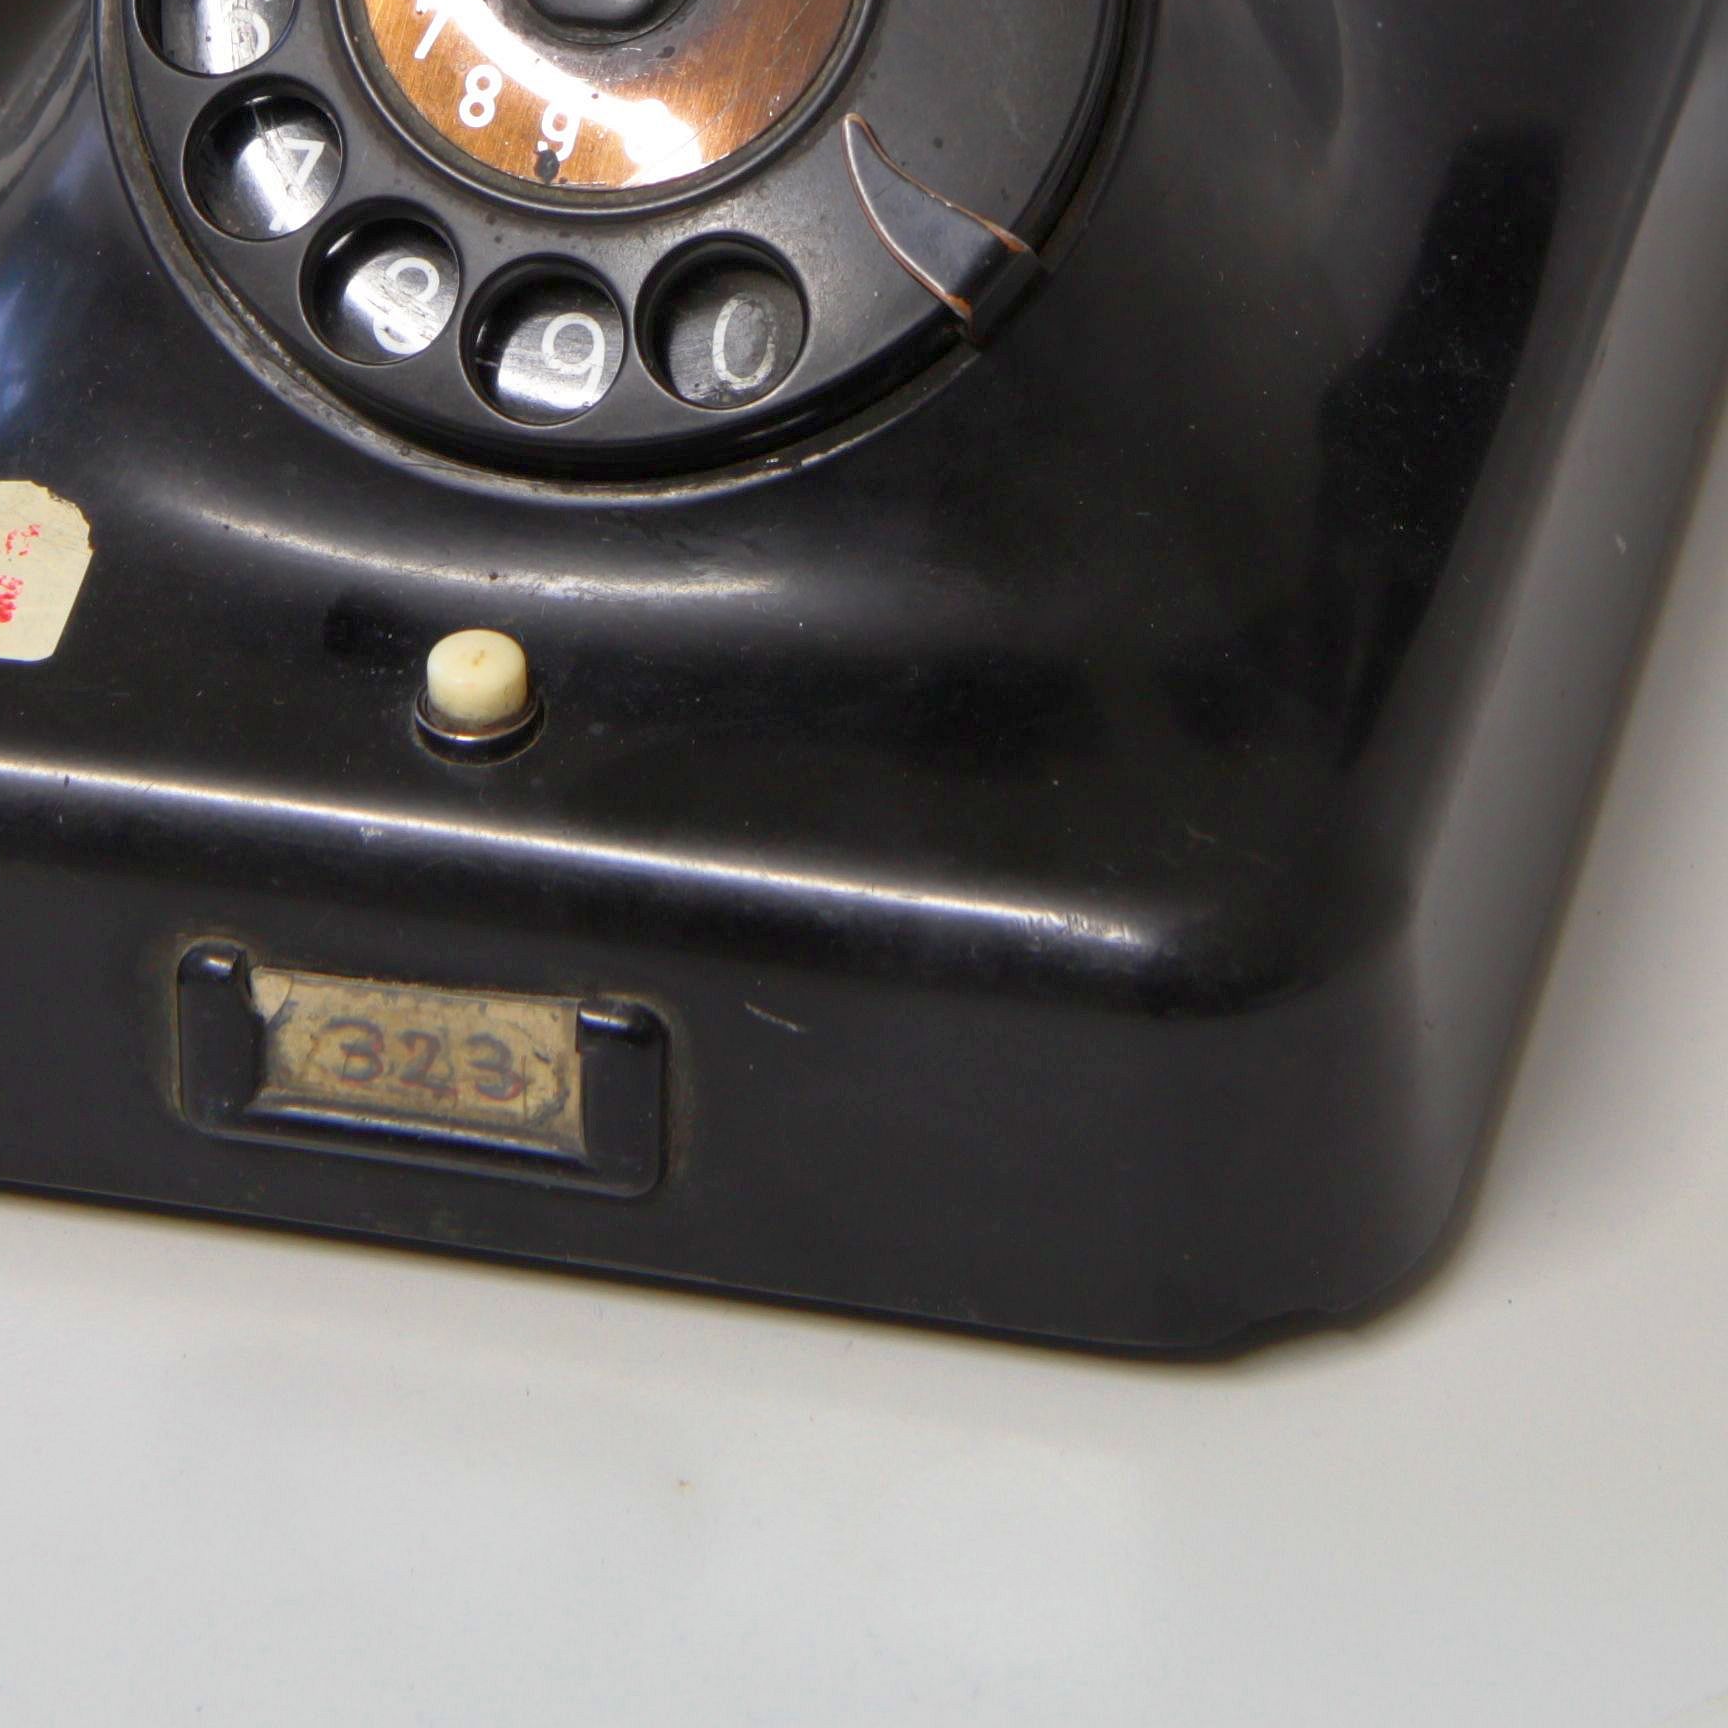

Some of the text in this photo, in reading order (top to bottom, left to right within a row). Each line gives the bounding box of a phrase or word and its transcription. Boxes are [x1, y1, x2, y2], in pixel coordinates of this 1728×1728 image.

[459, 64, 503, 128] 8
[538, 94, 582, 162] 9
[541, 312, 606, 402] 9
[713, 294, 775, 390] 0
[322, 1017, 526, 1101] 323
